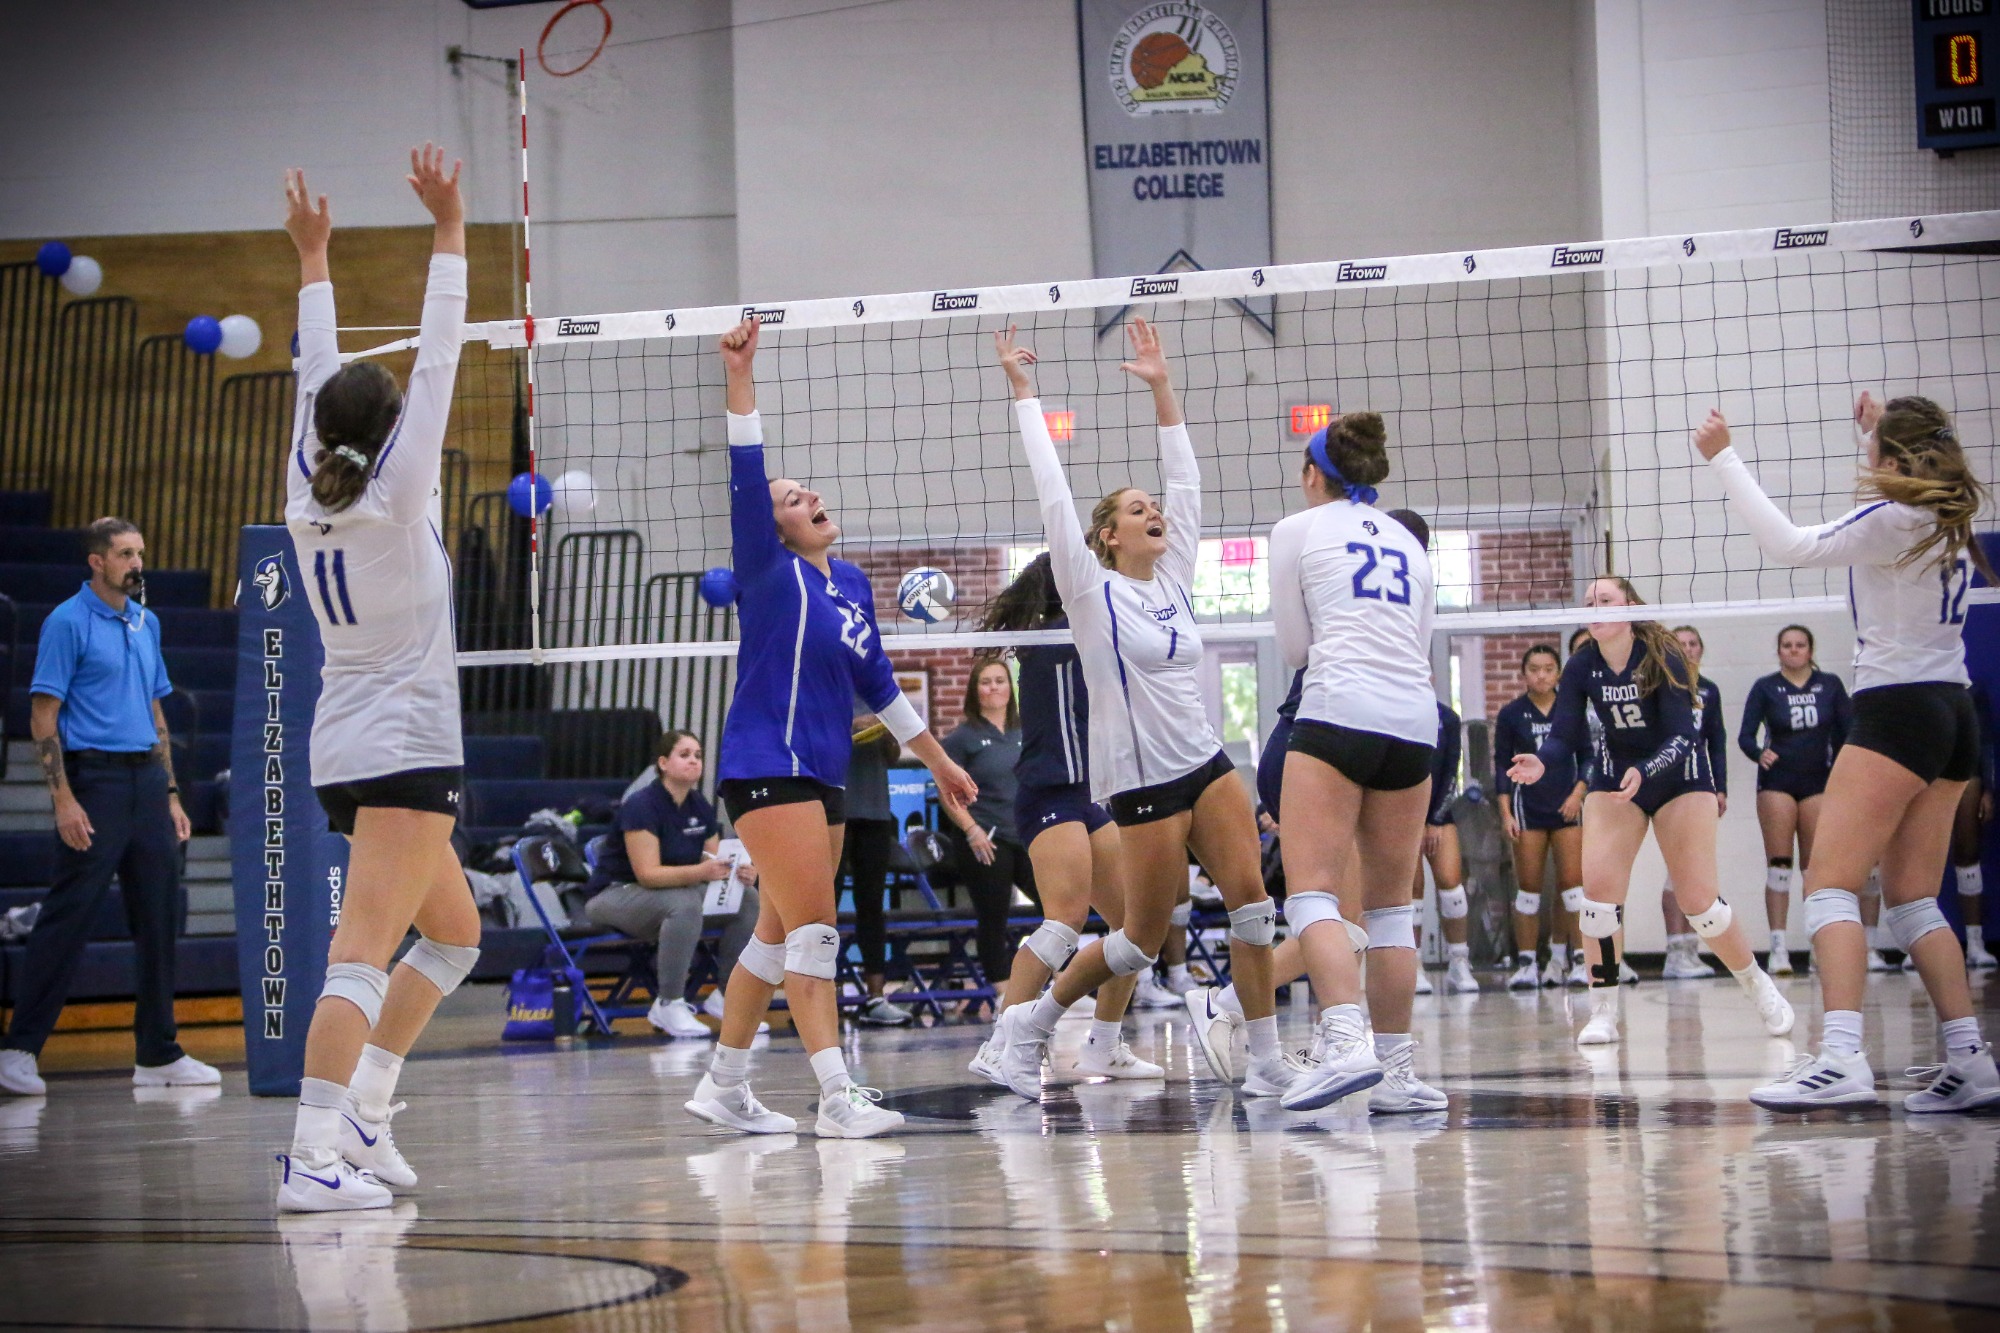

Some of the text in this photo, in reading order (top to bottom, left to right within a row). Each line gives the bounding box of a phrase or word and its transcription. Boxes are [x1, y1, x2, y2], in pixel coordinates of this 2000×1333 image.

[1950, 35, 1977, 85] 0
[1939, 105, 1983, 129] won
[1095, 139, 1261, 169] ELIZABETHTOWN
[1133, 173, 1224, 200] COLLEGE
[1775, 230, 1827, 248] ETOWN
[1553, 248, 1602, 266] ETOWN
[1338, 264, 1386, 280] ETOWN
[1131, 279, 1177, 295] ETOWN
[933, 294, 977, 310] ETOWN
[558, 320, 599, 334] ETOWN
[1345, 541, 1411, 606] 23
[314, 548, 359, 626] 11
[1939, 557, 1968, 625] 12
[836, 606, 872, 659] 22
[1601, 684, 1639, 701] HOOD
[1787, 694, 1816, 706] HOOD
[1610, 703, 1647, 729] 12
[1790, 705, 1819, 730] 20
[262, 628, 287, 1040] ELIZABETHTOWN
[327, 866, 342, 926] sports
